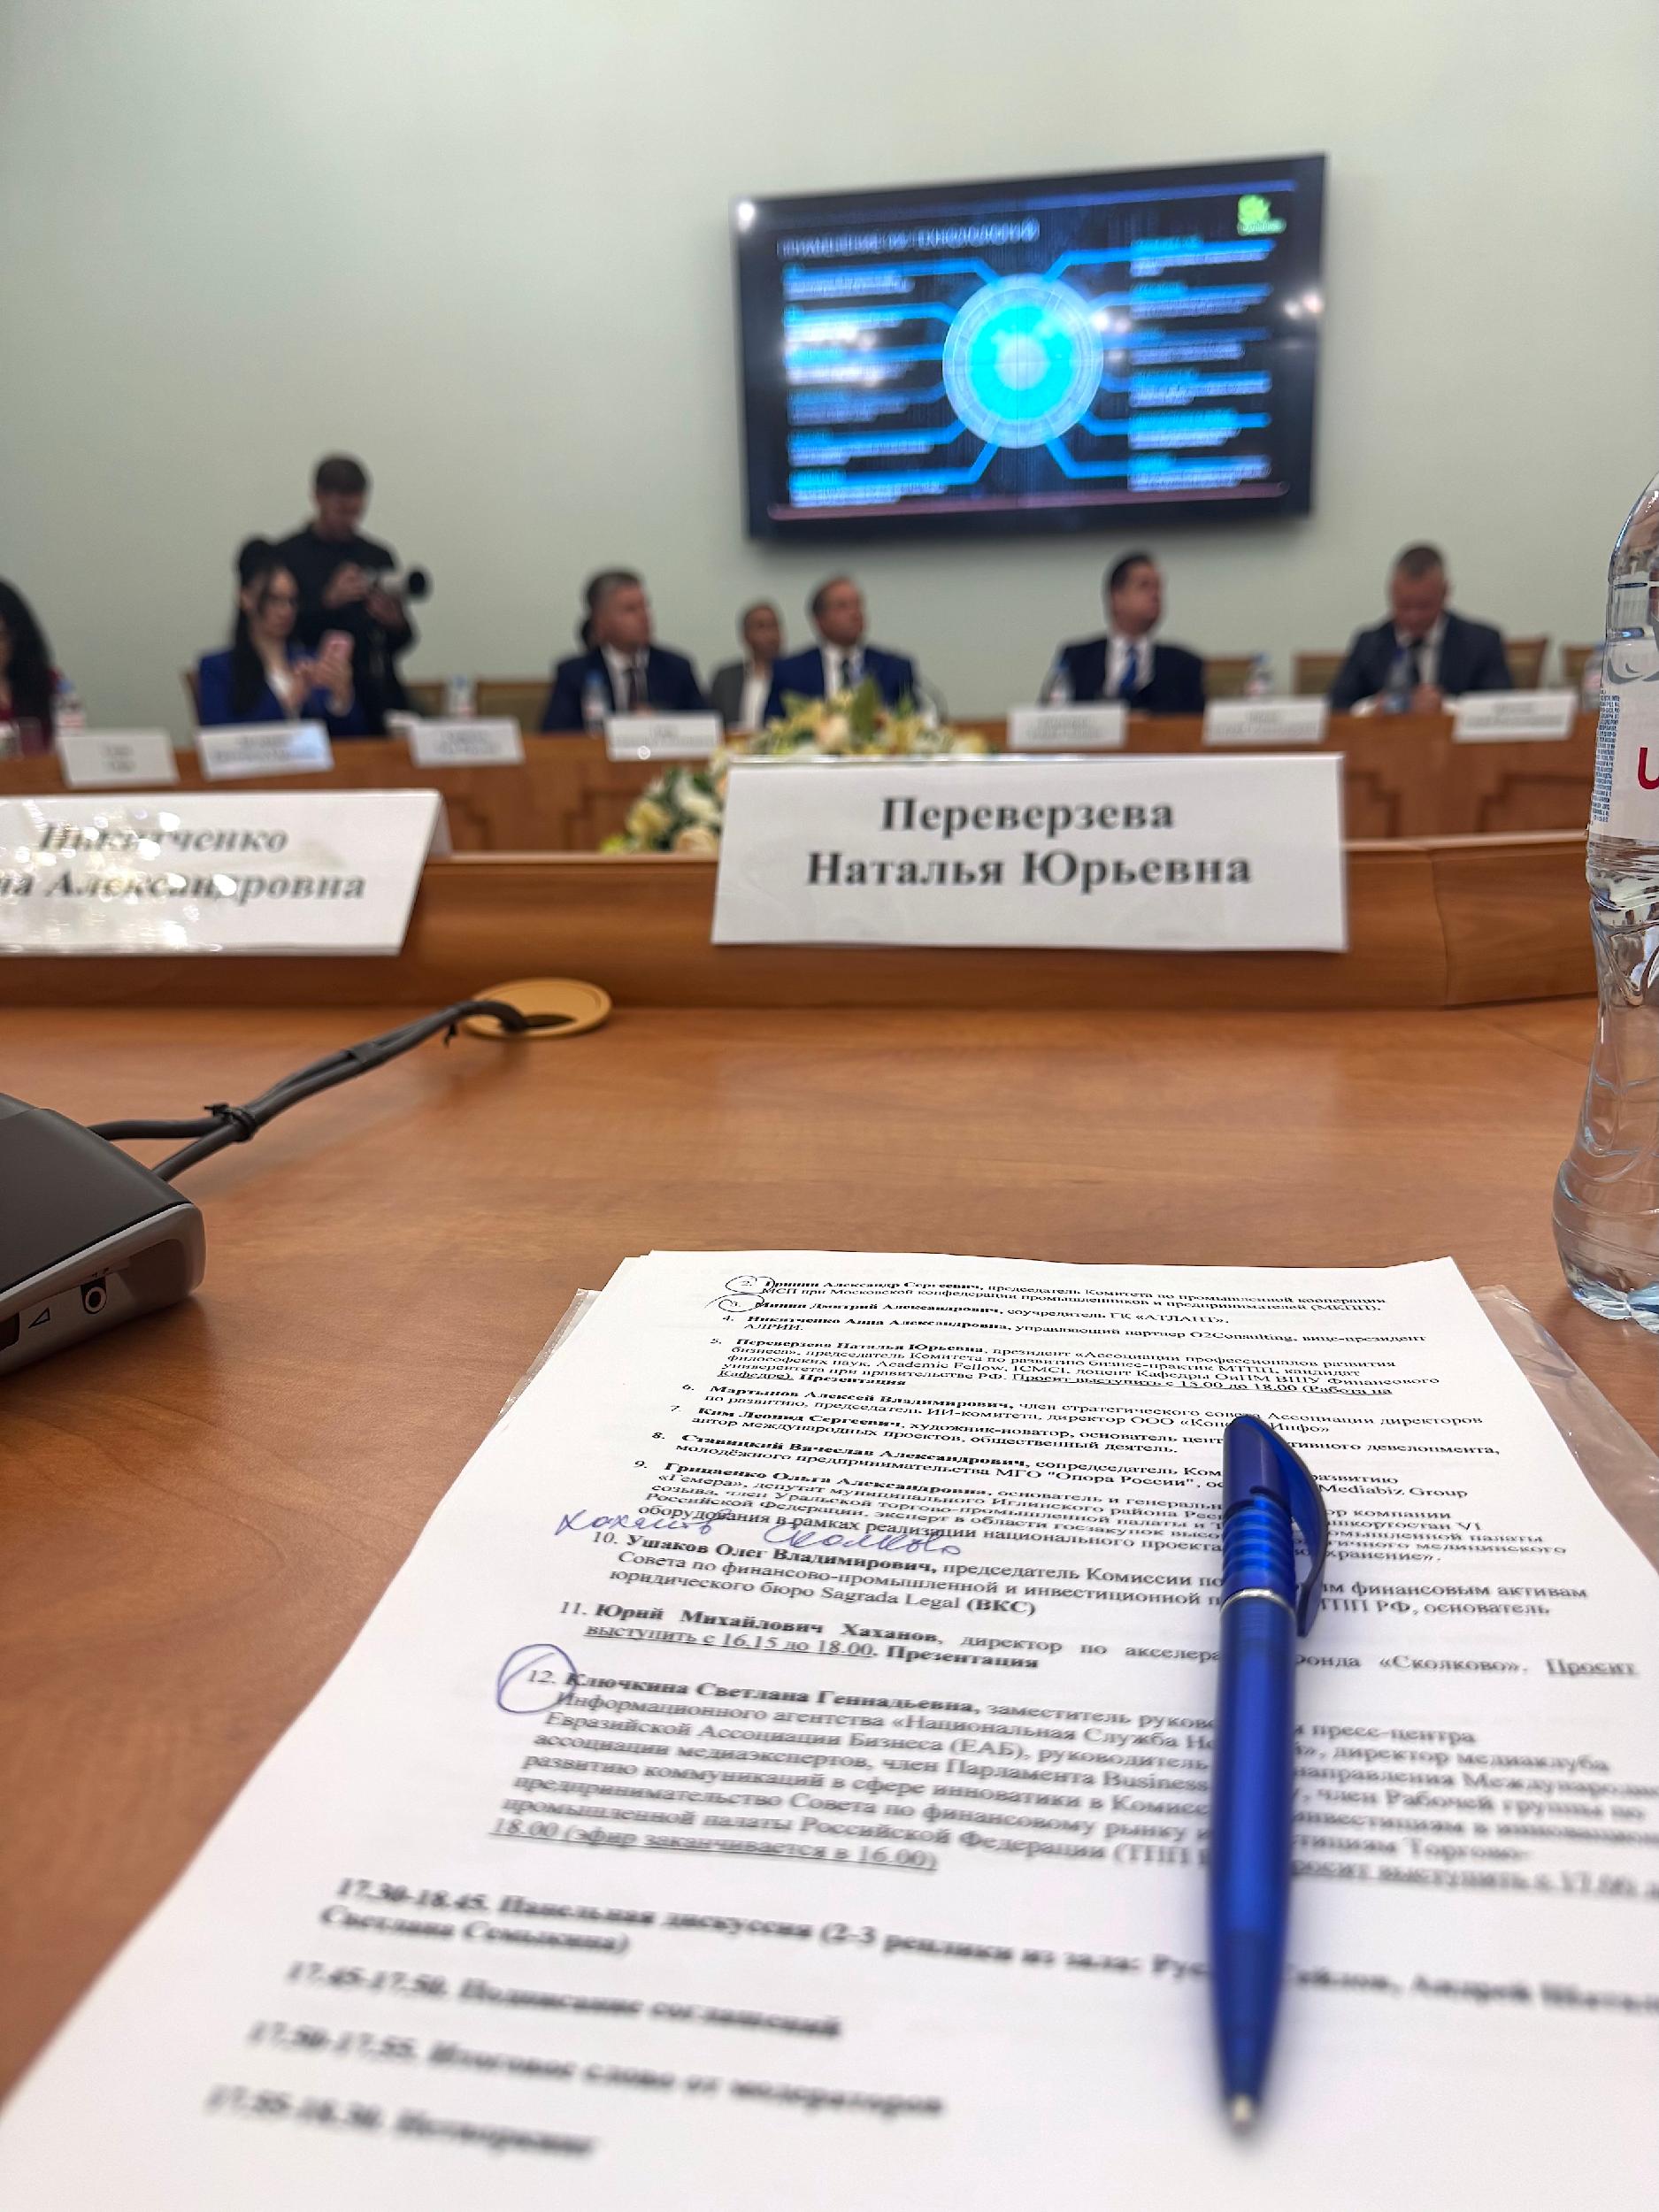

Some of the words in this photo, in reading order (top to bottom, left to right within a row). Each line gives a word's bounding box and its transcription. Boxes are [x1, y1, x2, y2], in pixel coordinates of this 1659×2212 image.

[881, 796, 1175, 840] Переверзева
[807, 849, 1004, 886] Наталья
[1021, 849, 1252, 894] Юрьевна
[829, 1287, 913, 1296] Московской
[1084, 1288, 1153, 1297] Комитета
[726, 1355, 827, 1364] философских
[876, 1359, 949, 1370] Academic
[1135, 1369, 1210, 1379] Кафедры
[805, 1349, 904, 1359] председатель
[910, 1352, 982, 1362] Комитета
[861, 1369, 973, 1379] правительстве
[992, 1348, 1071, 1357] президент
[698, 1405, 734, 1416] Ким
[738, 1408, 803, 1423] Леонид
[1079, 1432, 1177, 1442] основатель
[709, 1385, 798, 1397] Мартынов
[803, 1390, 874, 1402] Алексей
[1061, 1405, 1200, 1416] стратегического
[1267, 1411, 1374, 1424] Ассоциации
[1379, 1417, 1483, 1427] директоров
[814, 1402, 923, 1414] председатель
[1047, 1414, 1125, 1425] директор
[1130, 1416, 1174, 1425] ООО
[650, 1430, 665, 1440] 8.
[680, 1432, 783, 1449] Ставицкий
[788, 1441, 874, 1456] Вячеслав
[879, 1448, 1030, 1469] Александрович,
[1034, 1461, 1178, 1475] сопредседатель
[691, 1417, 739, 1428] автор
[741, 1420, 878, 1436] международных
[883, 1431, 965, 1443] проектов,
[970, 1434, 1099, 1449] общественный
[634, 1459, 648, 1468] 9.
[772, 1471, 831, 1484] Ольга
[997, 1490, 1102, 1503] основатель
[1352, 1509, 1451, 1519] компании
[795, 1455, 989, 1475] предпринимательства
[995, 1467, 1041, 1479] МГО
[1409, 1486, 1468, 1498] Group
[645, 1490, 753, 1508] Российской
[874, 1511, 949, 1524] эксперт
[970, 1517, 1048, 1529] области
[753, 1482, 825, 1494] депутат
[829, 1487, 985, 1505] муниципального
[1110, 1506, 1177, 1517] района
[774, 1492, 872, 1507] Уральской
[638, 1503, 770, 1524] оборудования
[795, 1517, 859, 1530] рамках
[983, 1530, 1134, 1548] национального
[1141, 1539, 1224, 1552] проекта
[593, 1531, 618, 1546] 10.
[626, 1533, 708, 1554] Ушаков
[715, 1541, 768, 1559] Олег
[772, 1547, 937, 1574] Владимирович,
[941, 1563, 1079, 1580] председатель
[1086, 1568, 1192, 1586] Комиссии
[1350, 1583, 1490, 1595] финансовым
[1497, 1586, 1587, 1597] активам
[618, 1549, 687, 1569] Совета
[691, 1560, 716, 1571] по
[721, 1563, 998, 1594] финансово-промышленной
[1005, 1585, 1018, 1594] и
[1023, 1586, 1201, 1604] инвестиционной
[1423, 1602, 1550, 1614] основатель
[609, 1571, 755, 1592] юридического
[759, 1579, 815, 1599] бюро
[820, 1585, 899, 1604] Sagrada
[904, 1592, 960, 1610] Legal
[966, 1597, 1036, 1618] (ВКС)
[558, 1597, 587, 1613] 11.
[595, 1601, 664, 1621] Юрий
[679, 1609, 824, 1635] Михайлович
[841, 1623, 941, 1647] Хаханов,
[960, 1635, 1062, 1655] директор
[1079, 1643, 1107, 1655] по
[584, 1624, 697, 1643] выступить
[702, 1633, 715, 1645] с
[722, 1631, 777, 1649] 16.15
[782, 1640, 810, 1654] до
[886, 1643, 1039, 1671] Презентация
[526, 1669, 556, 1685] 12.
[565, 1671, 688, 1694] Ключкина
[695, 1681, 809, 1702] Светлана
[816, 1689, 979, 1717] Геннадьевна,
[987, 1704, 1132, 1724] заместитель
[544, 1710, 693, 1736] Евразийской
[696, 1721, 842, 1748] Ассоциации
[848, 1732, 942, 1754] Бизнеса
[556, 1691, 767, 1720] Информационного
[772, 1710, 885, 1728] агентства
[1083, 1726, 1178, 1747] Служба
[1332, 1746, 1448, 1767] директор
[533, 1734, 671, 1758] ассоциации
[945, 1759, 1094, 1786] Парламента
[1102, 1770, 1208, 1793] Business
[851, 1780, 925, 1800] сфере
